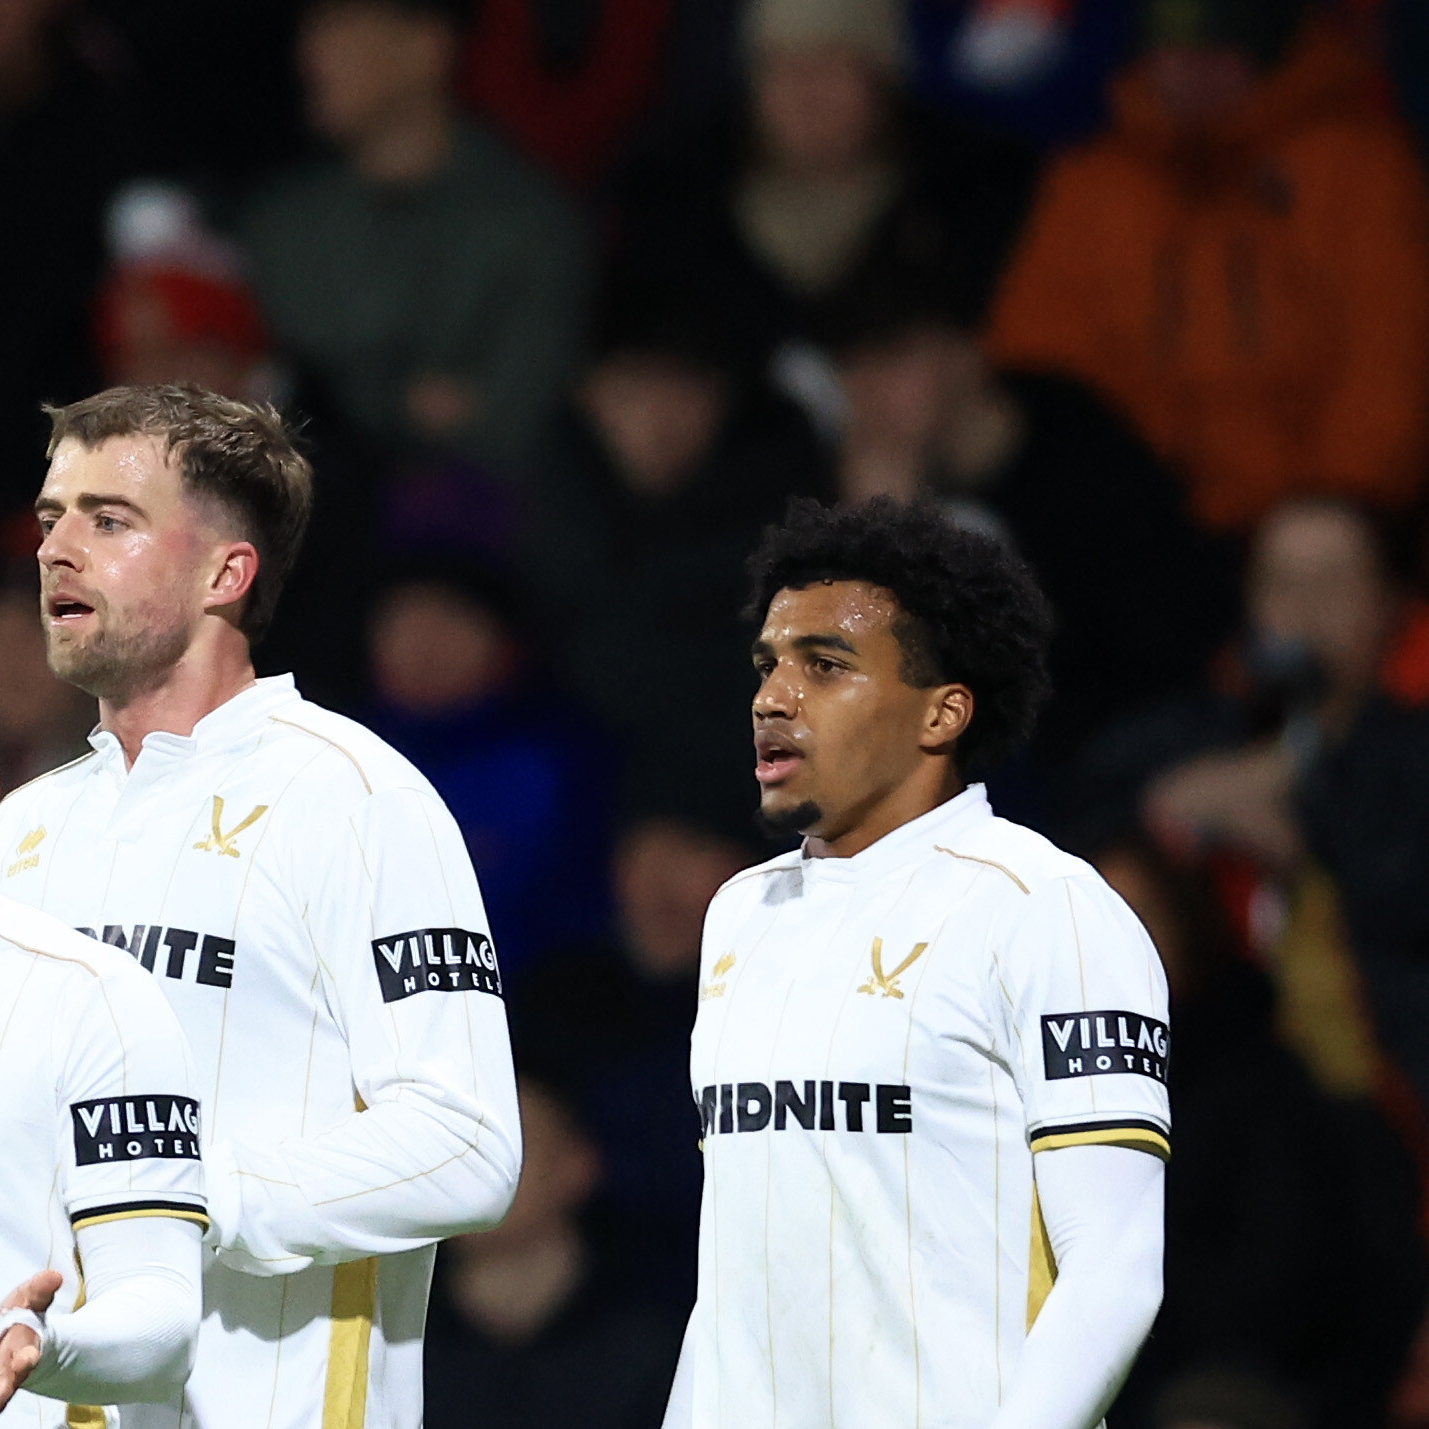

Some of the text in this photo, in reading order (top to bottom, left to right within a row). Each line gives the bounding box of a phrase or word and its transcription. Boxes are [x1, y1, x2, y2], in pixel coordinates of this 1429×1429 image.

[378, 934, 498, 974] VILLAG
[1047, 1016, 1168, 1058] VILLAG
[1068, 1054, 1166, 1082] HOTEL
[77, 1100, 201, 1138] VILLAG
[98, 1138, 199, 1159] HOTEL
